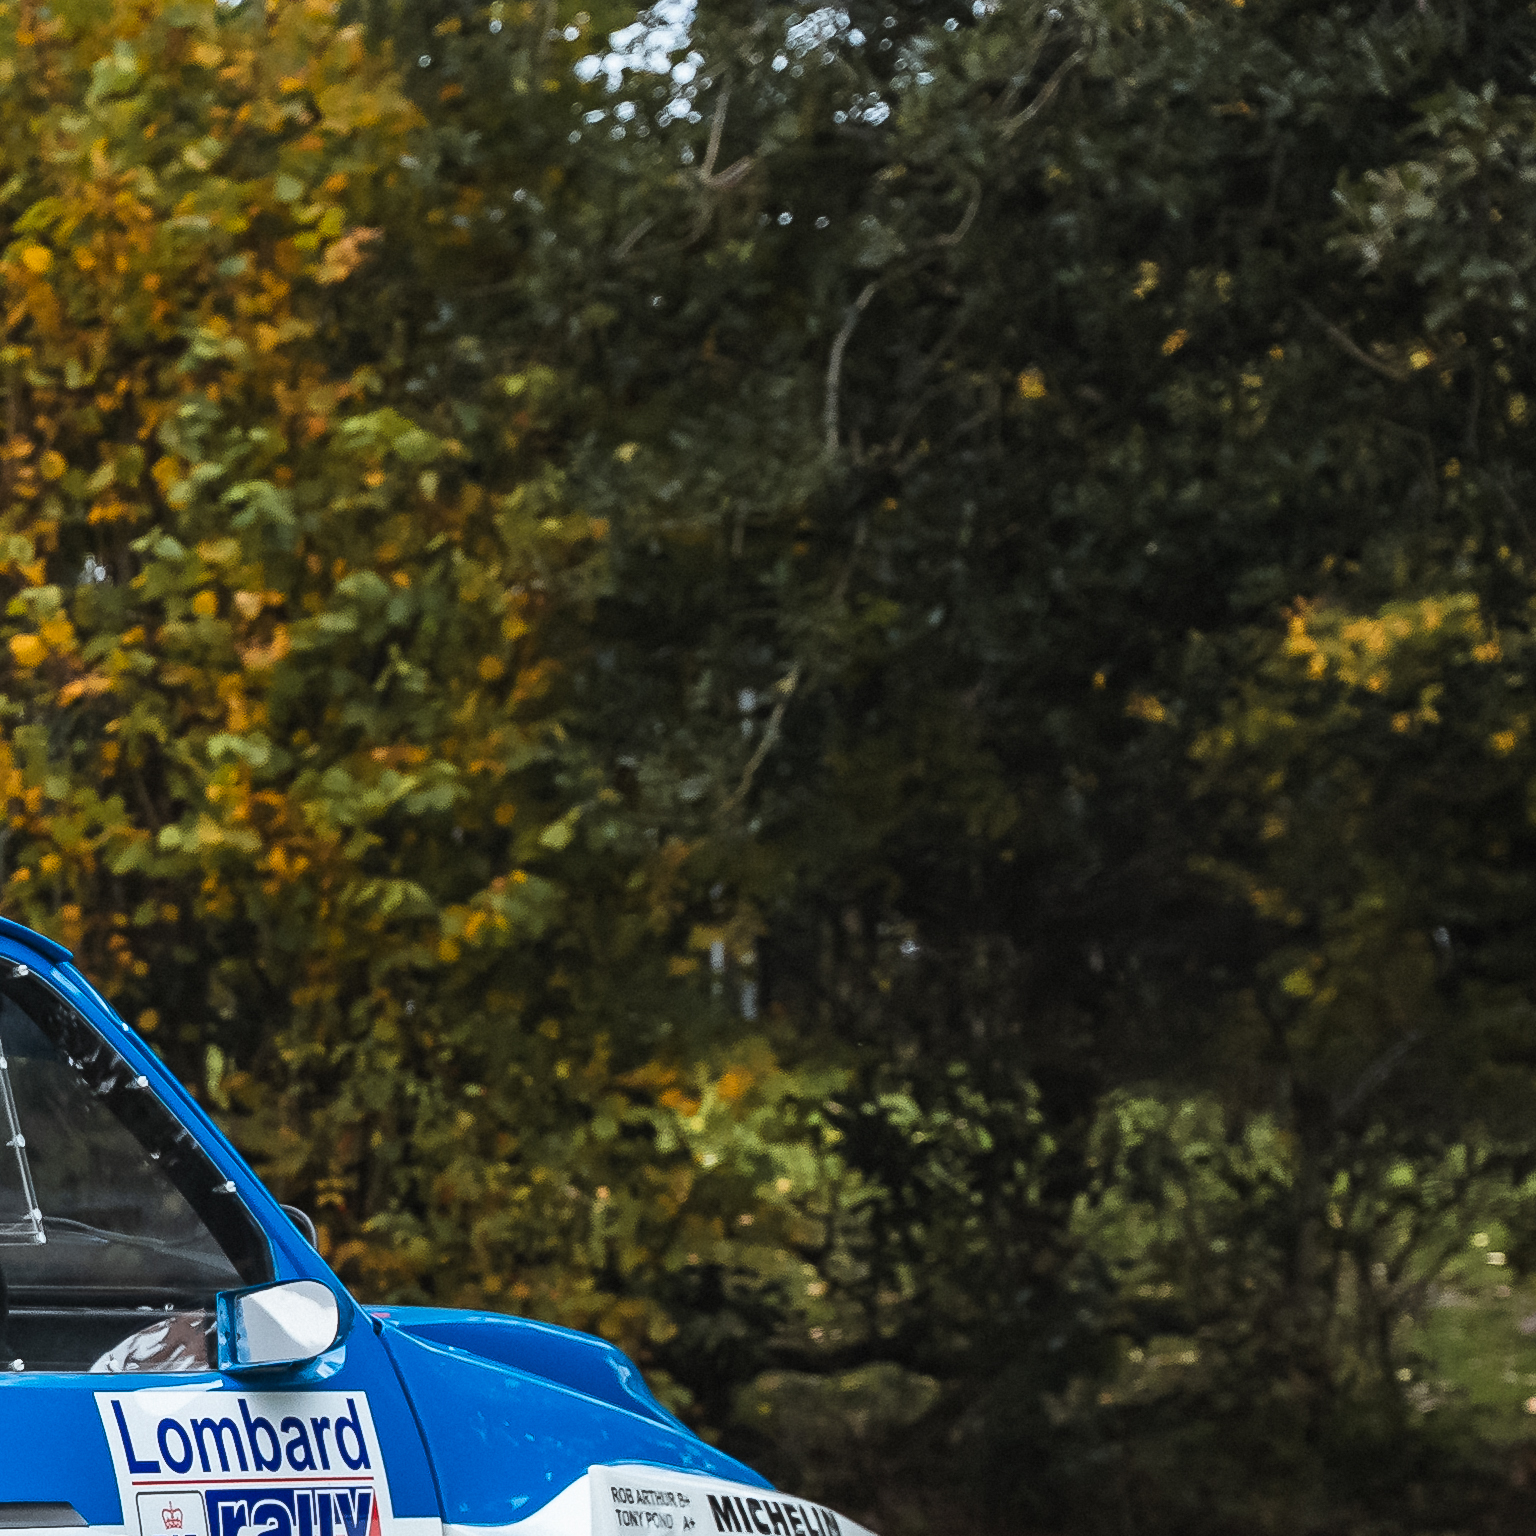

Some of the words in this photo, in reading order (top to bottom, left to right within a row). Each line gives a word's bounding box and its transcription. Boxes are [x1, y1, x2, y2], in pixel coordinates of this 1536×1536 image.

[111, 1398, 372, 1475] Lombard
[610, 1486, 635, 1504] ROB
[636, 1490, 678, 1507] ARTHUR
[615, 1508, 644, 1527] TONY
[645, 1511, 674, 1529] POND
